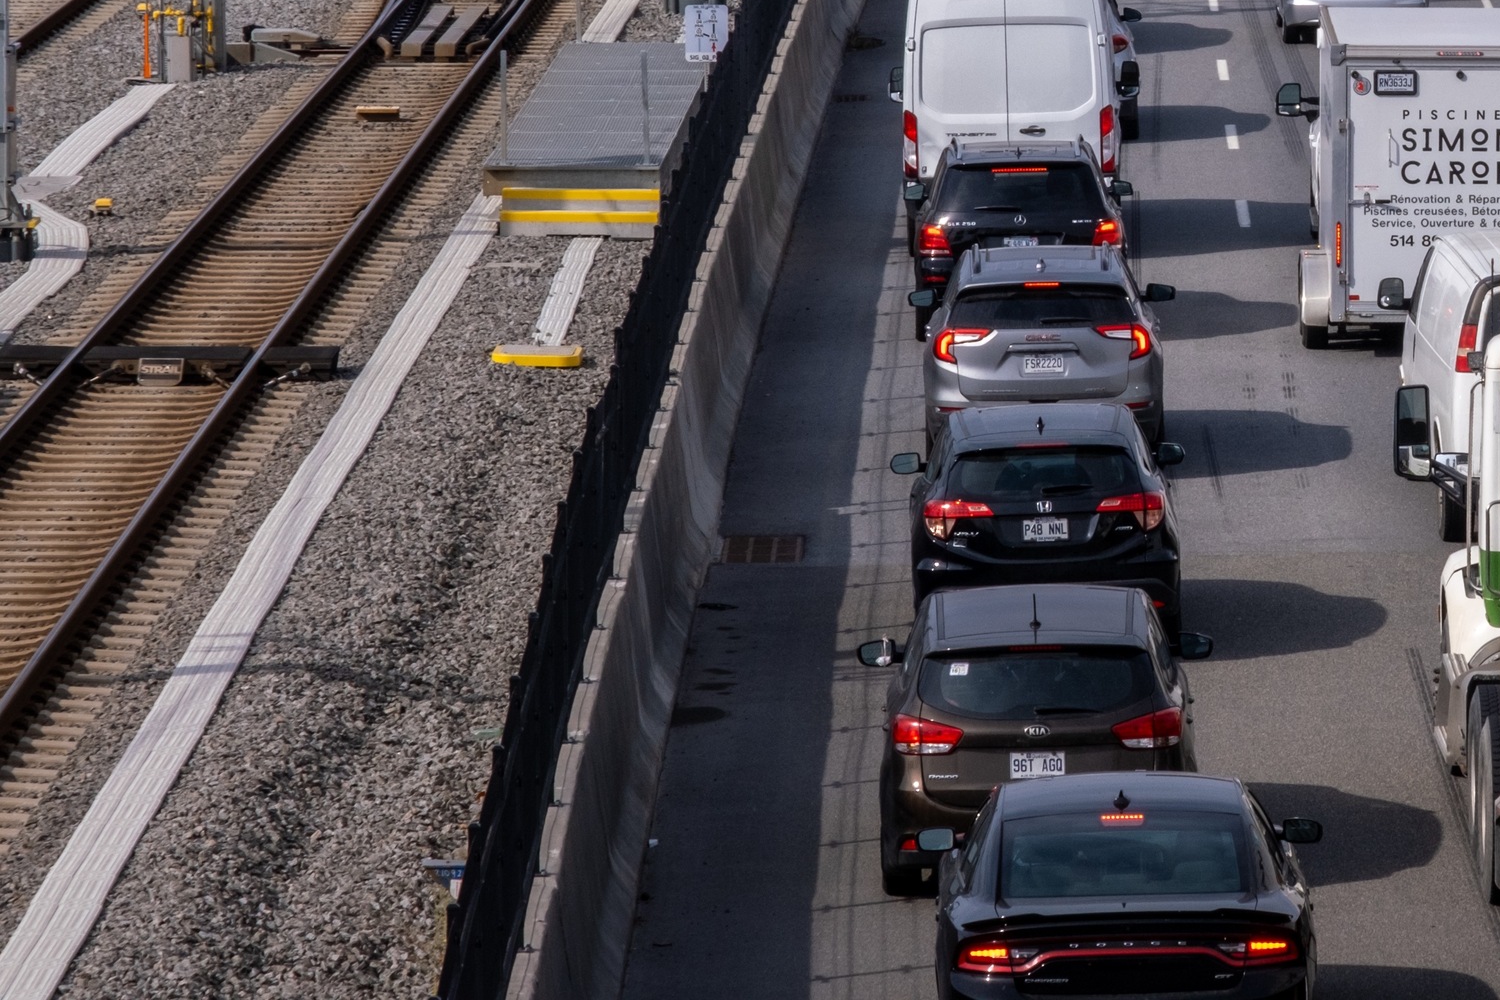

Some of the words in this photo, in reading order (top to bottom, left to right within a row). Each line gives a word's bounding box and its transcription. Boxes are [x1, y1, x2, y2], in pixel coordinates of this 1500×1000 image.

[1379, 77, 1413, 88] RN3633J
[1390, 194, 1451, 204] Rénovation
[1455, 195, 1463, 204] &
[1363, 207, 1408, 216] Piscines
[1413, 206, 1467, 217] creusées,
[1371, 219, 1416, 229] Service,
[1420, 219, 1474, 228] Ouverture
[1480, 219, 1487, 228] &
[1390, 235, 1415, 247] 514
[141, 364, 182, 374] STRAIL
[1025, 358, 1062, 369] FSR2220
[1024, 524, 1043, 535] P48
[1049, 523, 1067, 535] NNL
[1029, 727, 1046, 736] KIA
[1013, 759, 1033, 772] 96T
[1042, 758, 1063, 772] AGQ
